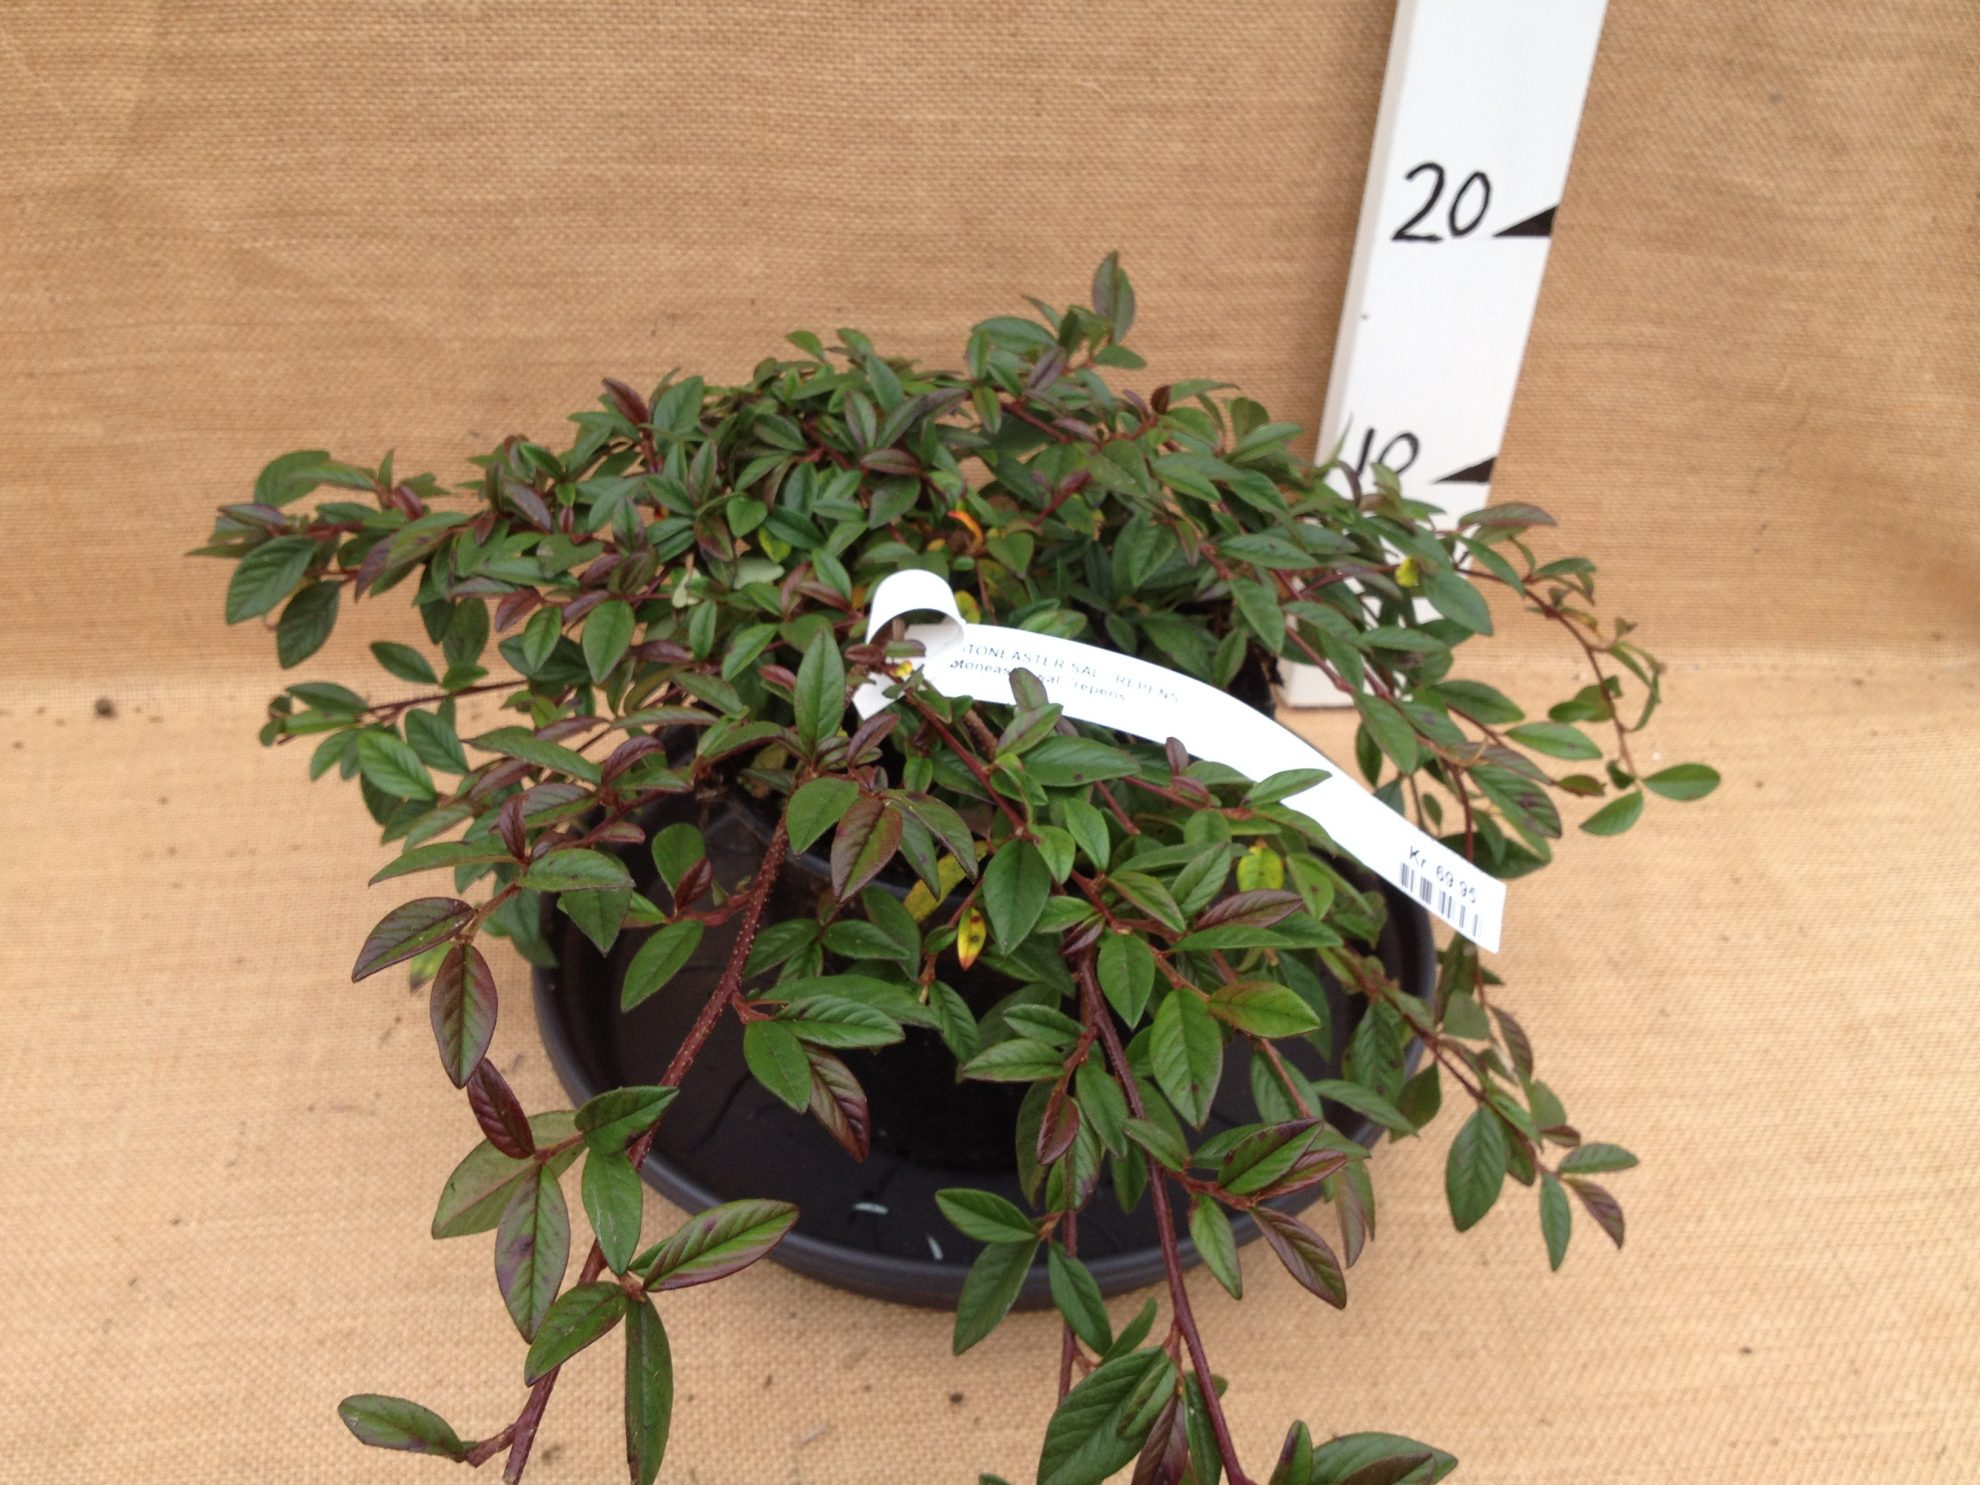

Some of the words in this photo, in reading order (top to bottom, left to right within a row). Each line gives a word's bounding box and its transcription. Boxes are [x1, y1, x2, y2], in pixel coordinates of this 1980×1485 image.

[1391, 161, 1492, 243] 20
[1356, 427, 1421, 478] 10
[963, 643, 1065, 669] TONEASTER
